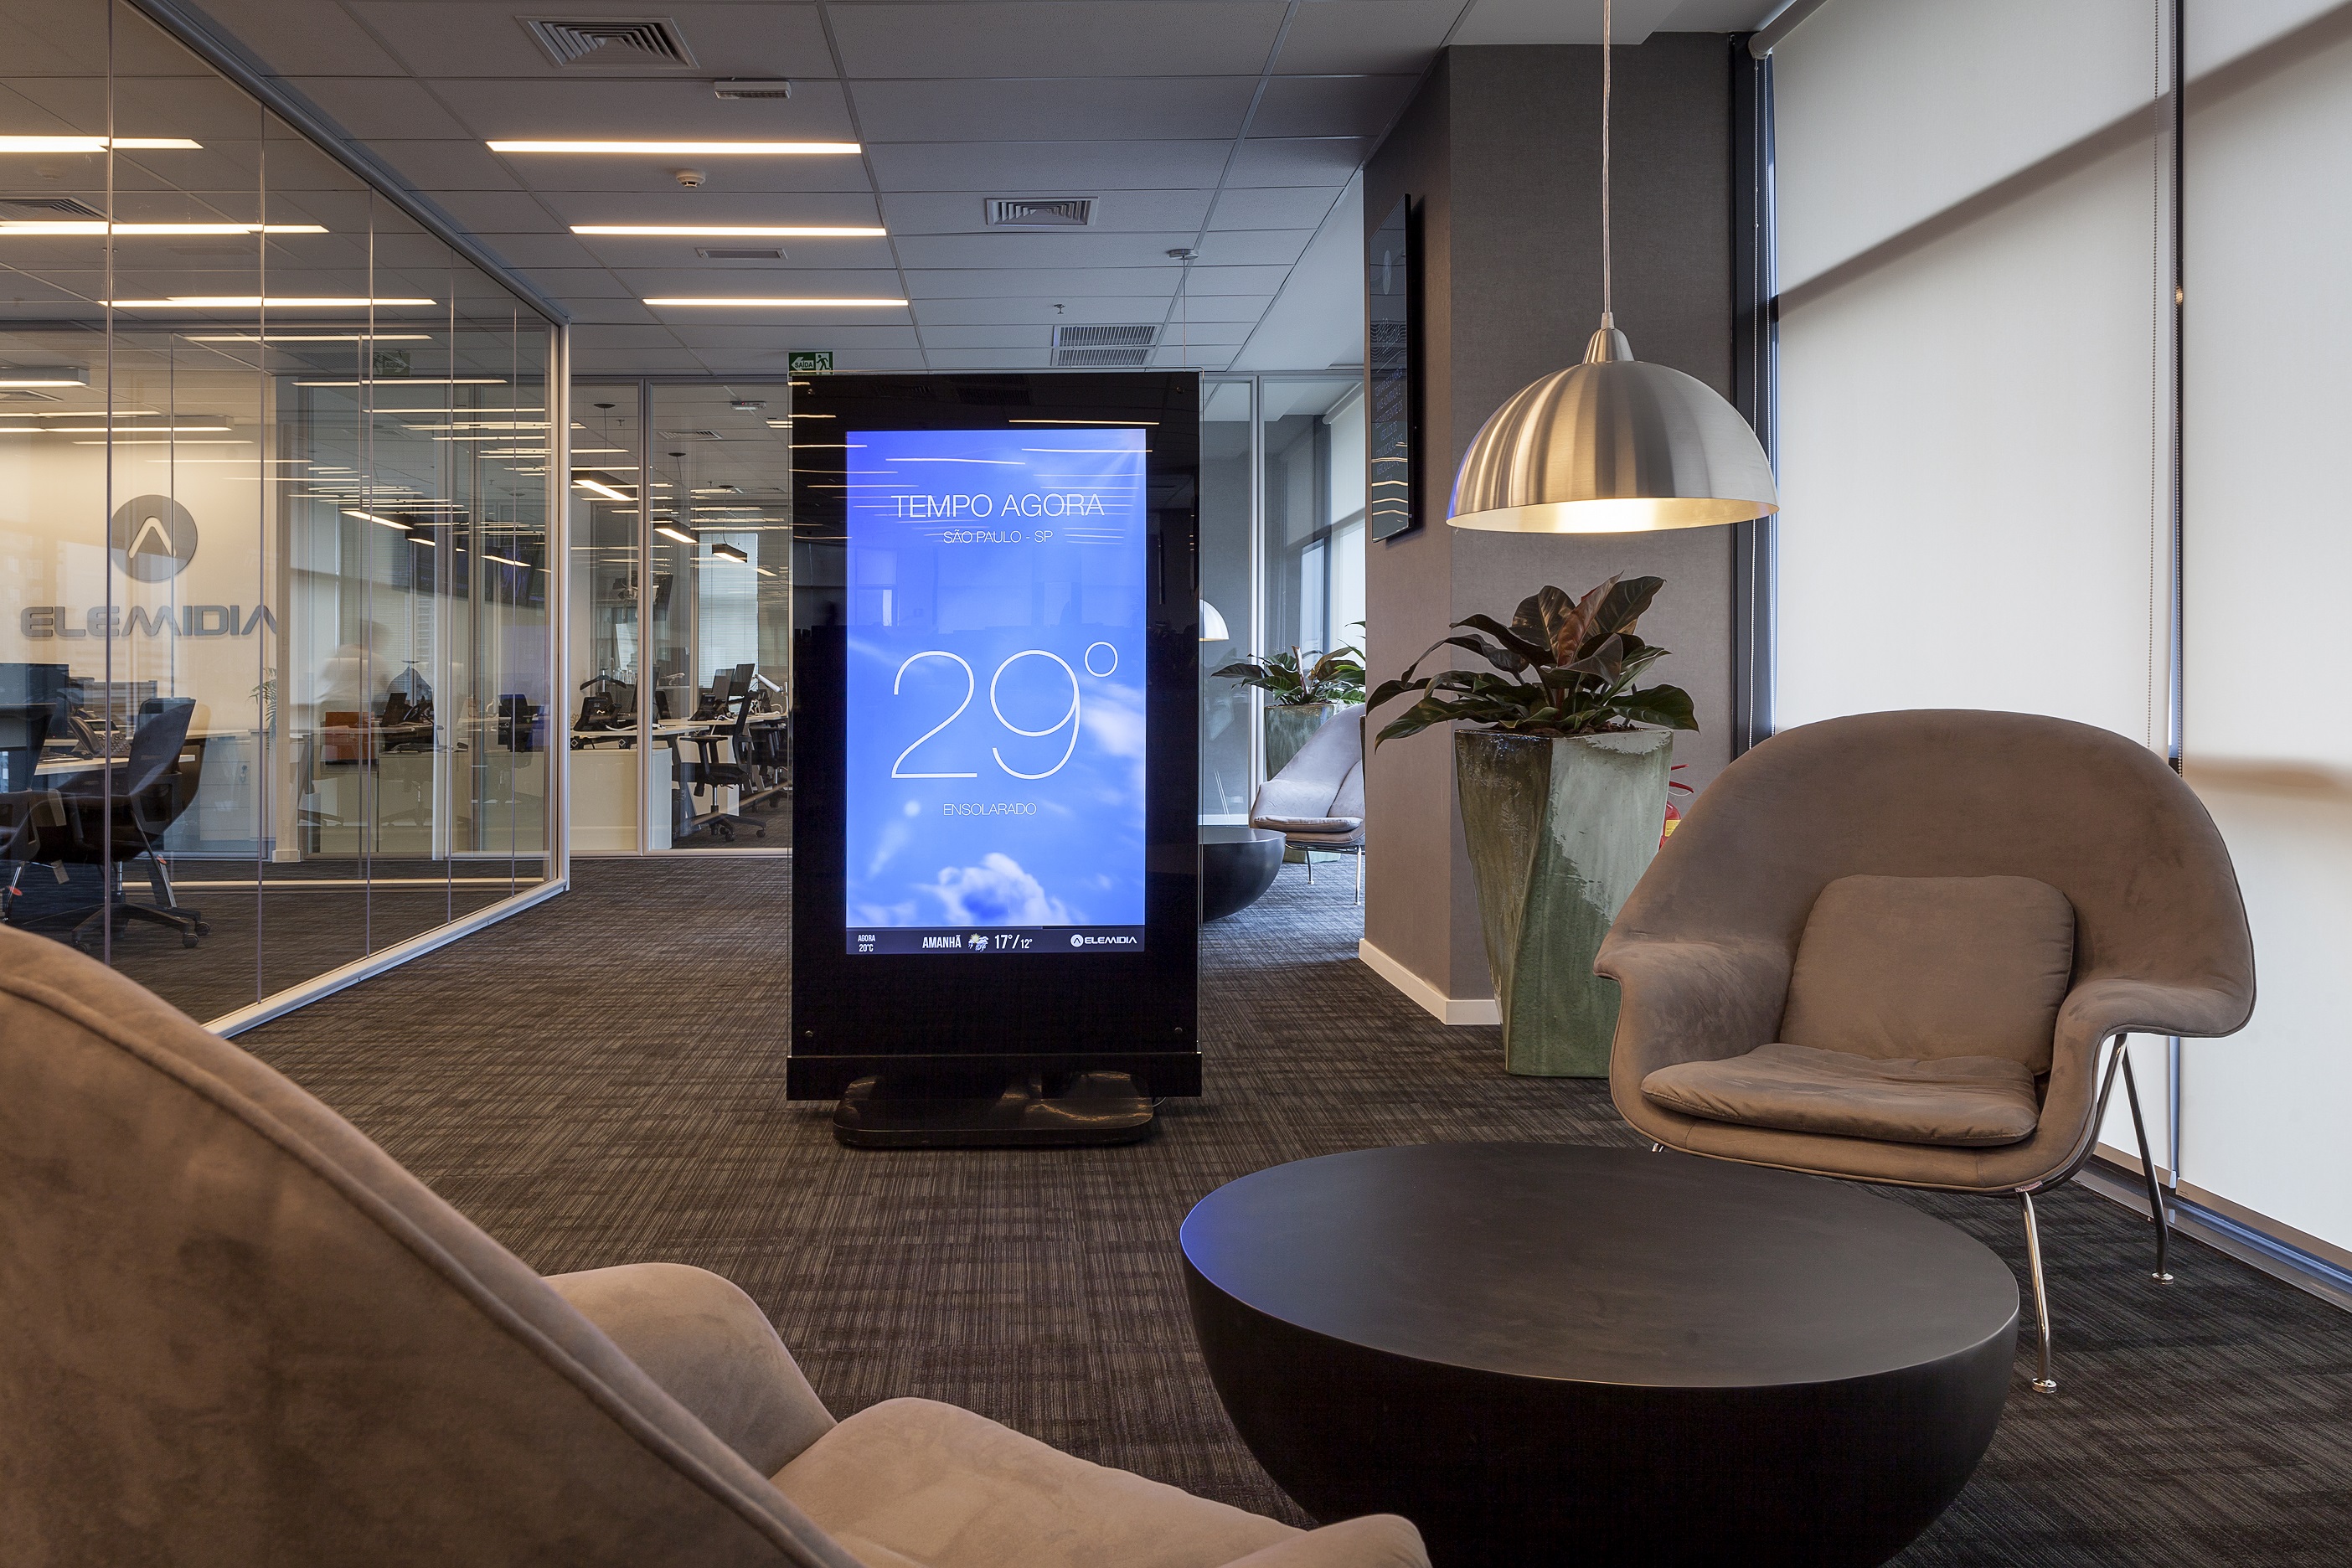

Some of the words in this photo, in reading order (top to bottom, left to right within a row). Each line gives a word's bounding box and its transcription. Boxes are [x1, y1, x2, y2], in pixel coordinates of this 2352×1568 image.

[890, 493, 993, 518] TEMPO
[1000, 493, 1105, 518] AGORA
[943, 529, 972, 544] SÃO
[976, 530, 1022, 544] PAULO
[1034, 530, 1053, 543] SP
[943, 802, 1037, 816] ENSOLARADO
[858, 934, 876, 942] AGORA
[922, 934, 962, 949] AMANHÃ
